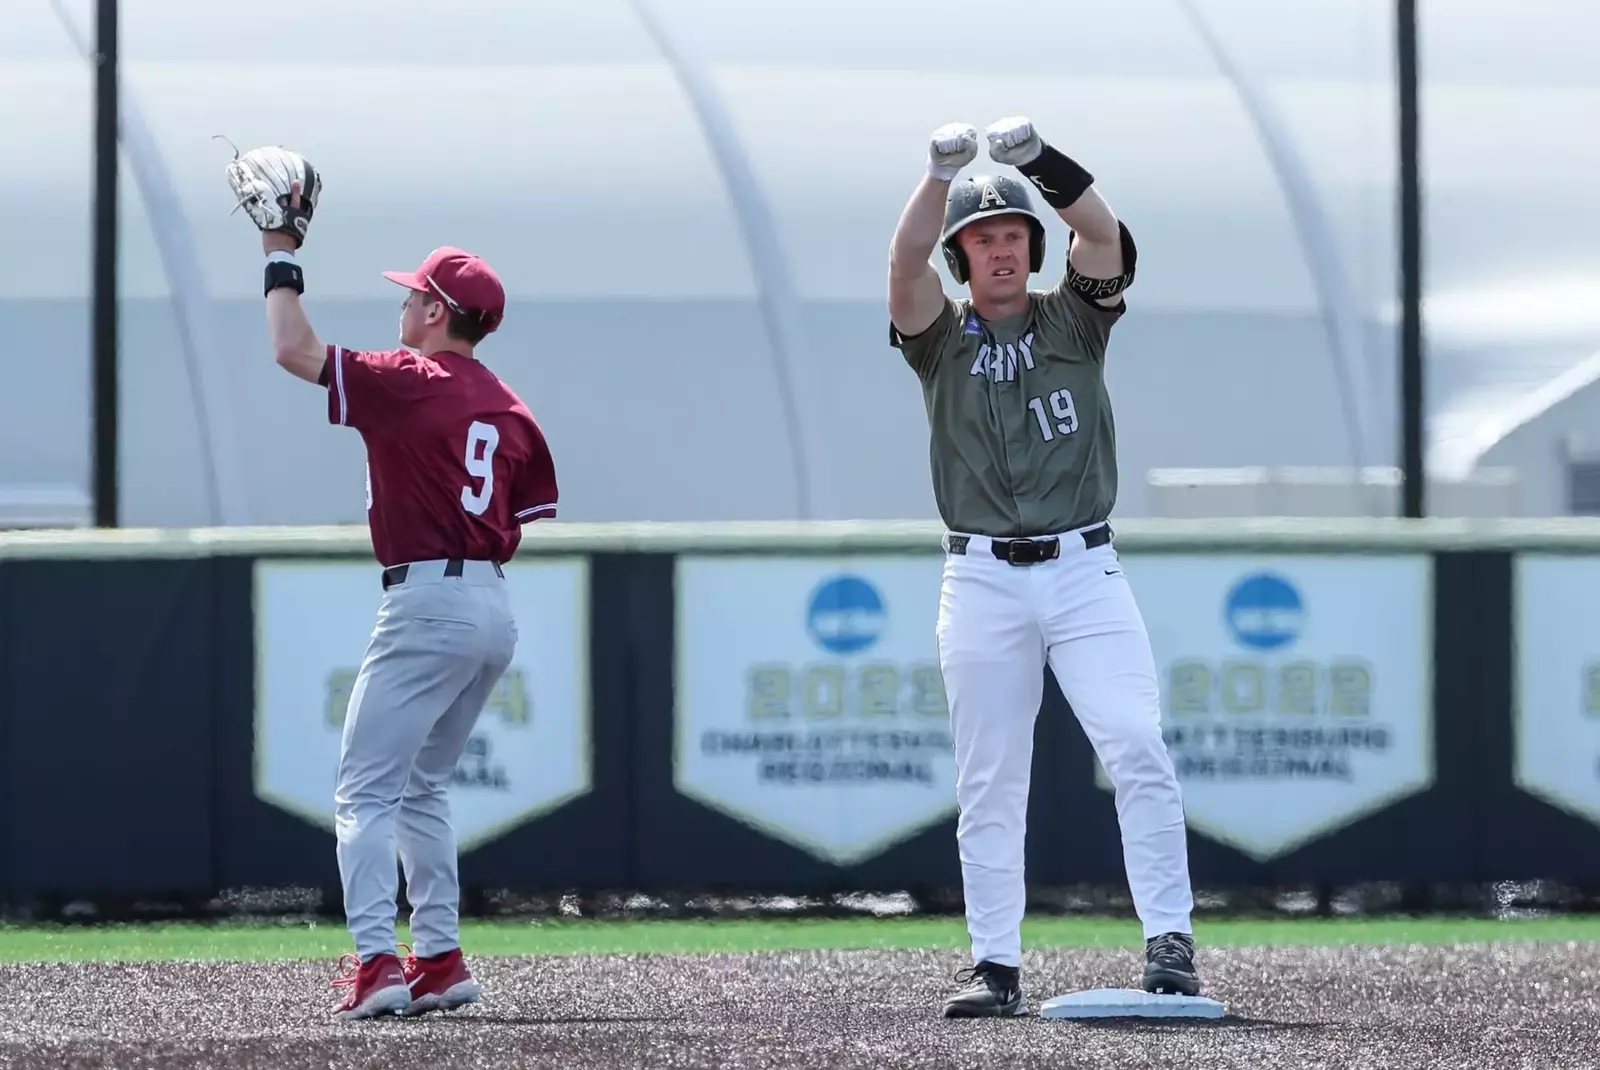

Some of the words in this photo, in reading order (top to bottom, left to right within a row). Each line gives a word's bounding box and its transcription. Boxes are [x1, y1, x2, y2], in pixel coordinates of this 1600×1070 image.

[979, 183, 1007, 210] A
[1028, 388, 1079, 442] 19
[460, 420, 500, 516] 9
[1168, 660, 1371, 717] 2022
